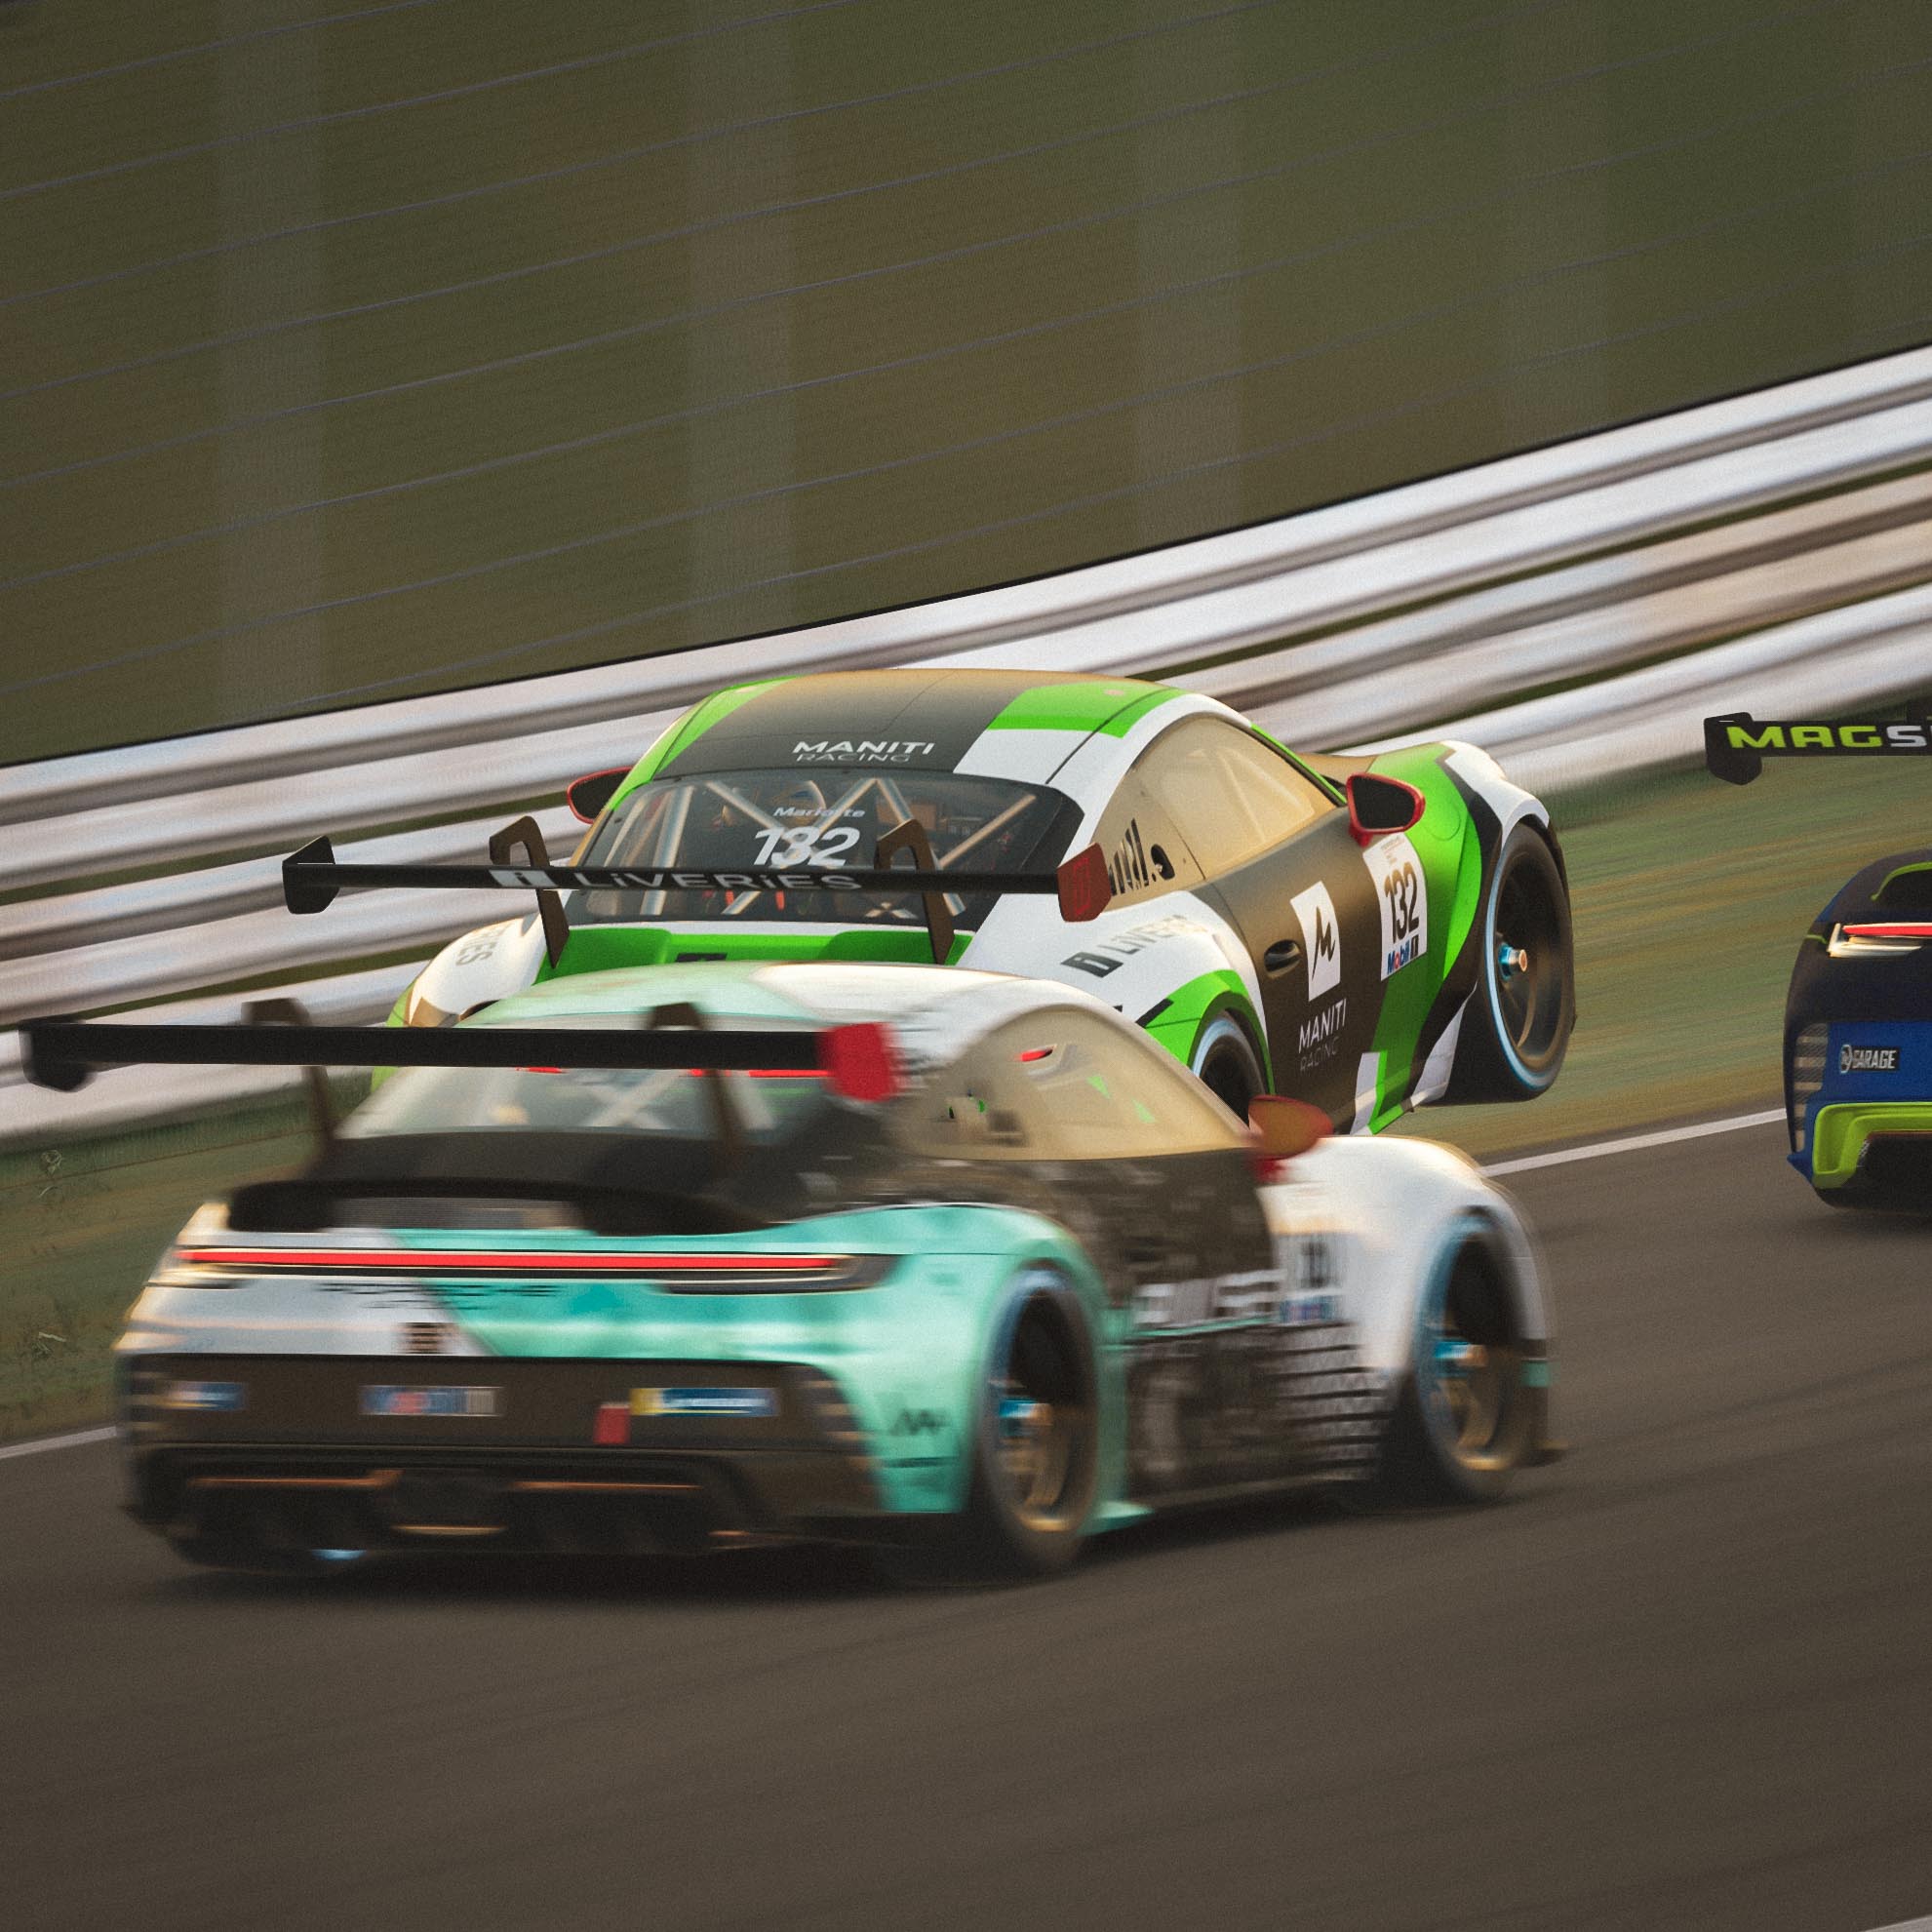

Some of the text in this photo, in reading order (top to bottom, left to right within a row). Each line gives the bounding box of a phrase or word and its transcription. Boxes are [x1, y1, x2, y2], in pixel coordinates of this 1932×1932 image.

[792, 740, 935, 755] MANITI
[1726, 725, 1932, 748] MAGS
[796, 753, 910, 763] RACING
[753, 826, 860, 867] 132
[1384, 861, 1419, 944] 132
[1387, 940, 1410, 975] Mobil
[1298, 997, 1347, 1054] MANITI
[1852, 1049, 1897, 1070] GARAGE
